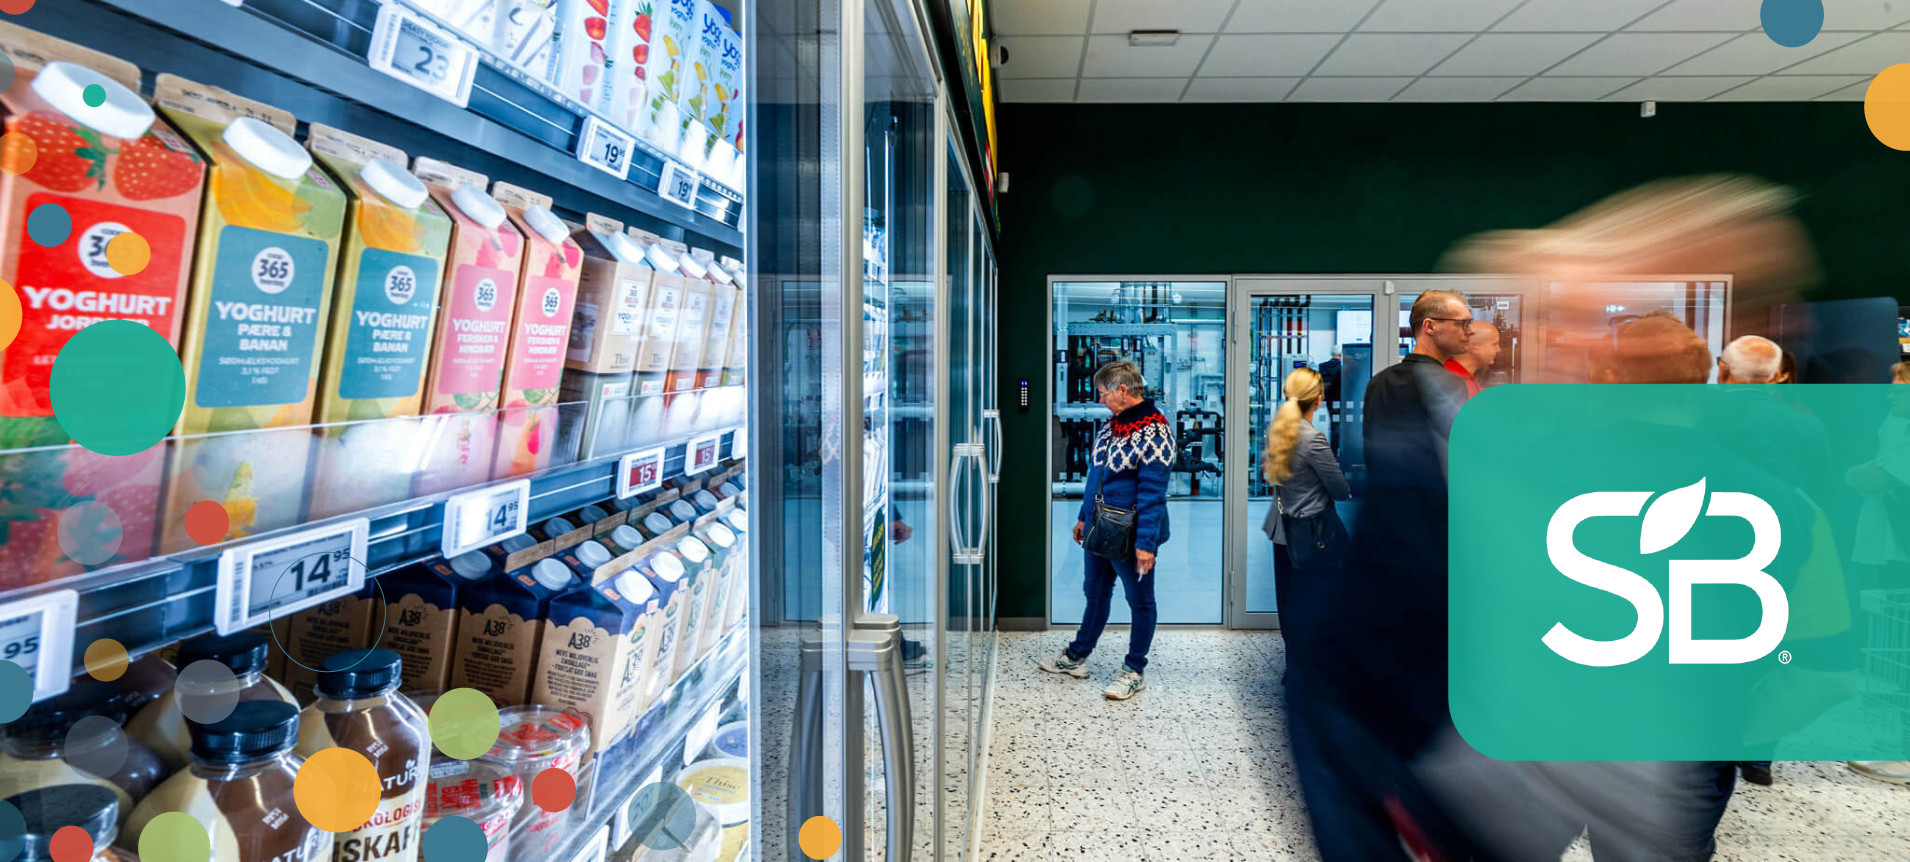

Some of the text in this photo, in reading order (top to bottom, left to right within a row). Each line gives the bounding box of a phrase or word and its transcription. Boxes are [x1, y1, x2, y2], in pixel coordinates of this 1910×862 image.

[415, 45, 449, 81] 23
[605, 143, 619, 163] 19
[678, 181, 689, 197] 19
[258, 259, 288, 279] 365
[389, 275, 412, 292] 365
[22, 285, 172, 316] YOGHURT
[477, 287, 494, 301] 365
[215, 301, 316, 324] YOGHURT
[356, 310, 428, 329] YOGHURT
[452, 318, 506, 333] YOGHURT
[524, 322, 567, 336] YOGHURT
[239, 339, 288, 351] BANAN
[373, 342, 408, 352] BANAN
[640, 464, 652, 482] 15
[484, 501, 520, 532] 14 95
[290, 553, 331, 592] 14
[333, 547, 350, 562] 95
[399, 608, 423, 626] A38
[483, 619, 506, 636] A38
[4, 636, 39, 659] 95
[567, 631, 592, 650] A38
